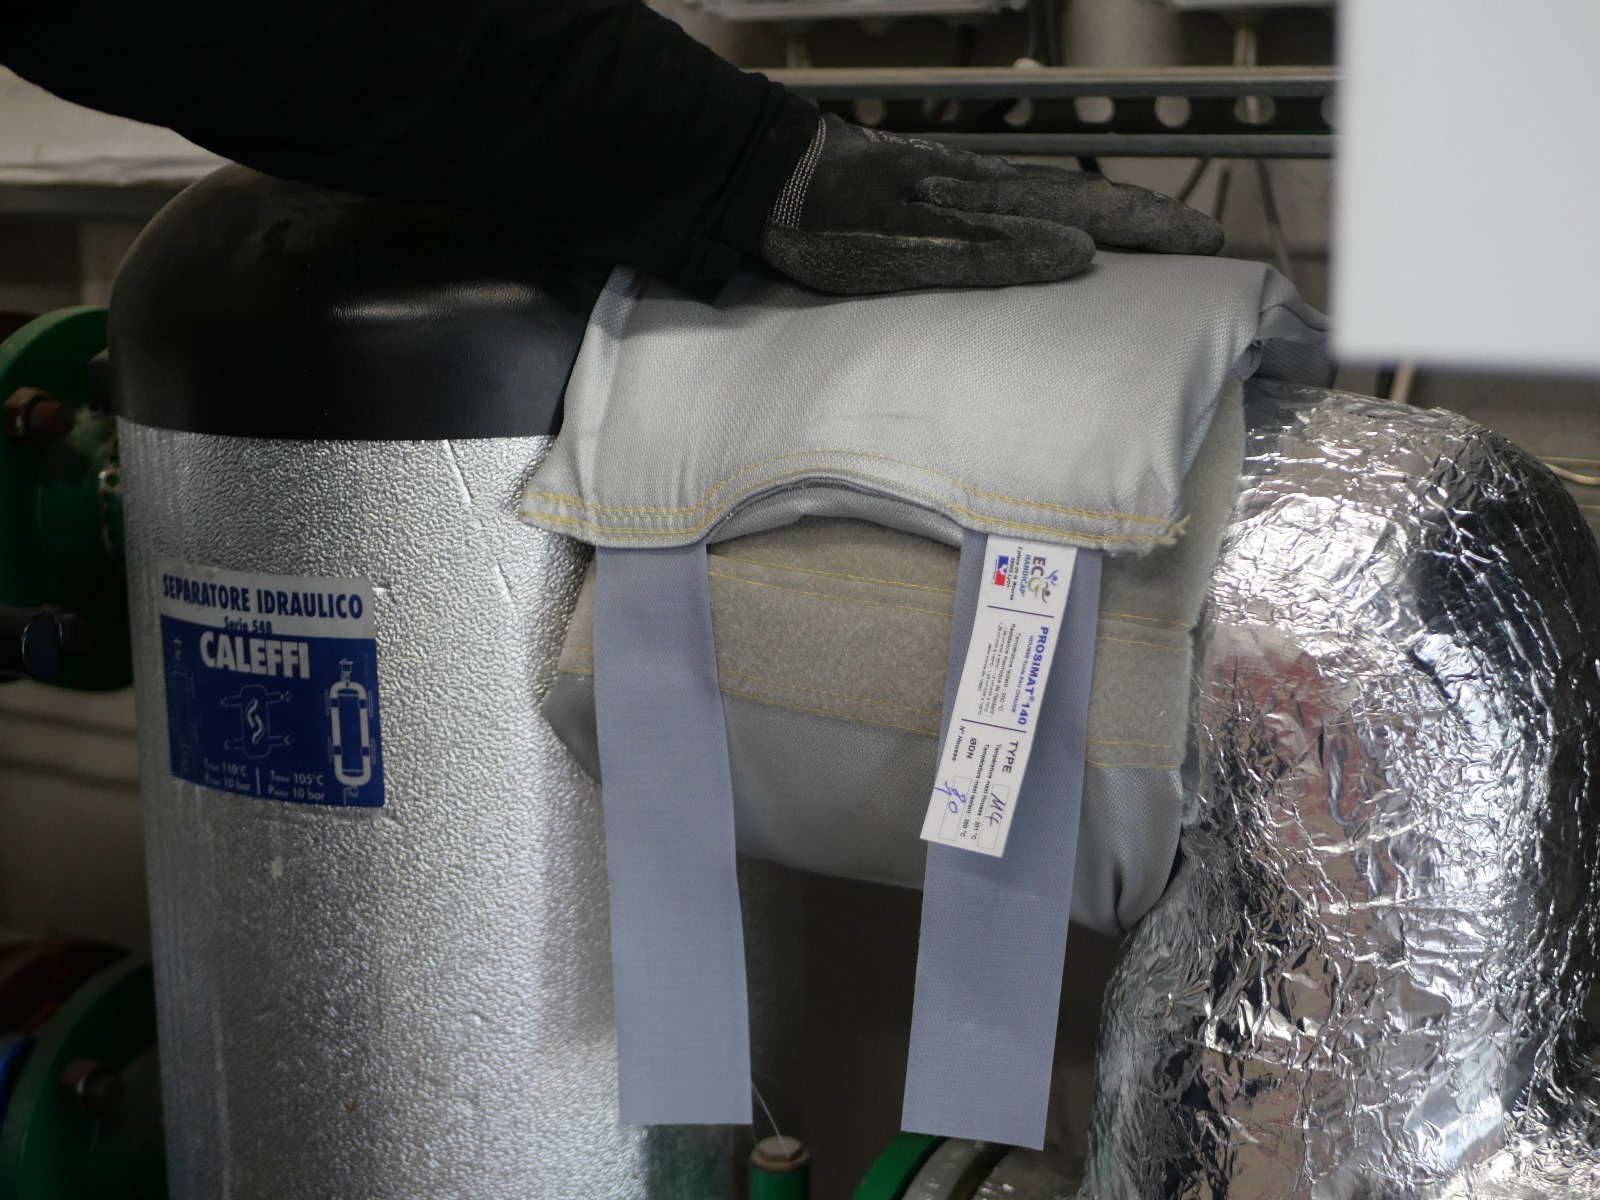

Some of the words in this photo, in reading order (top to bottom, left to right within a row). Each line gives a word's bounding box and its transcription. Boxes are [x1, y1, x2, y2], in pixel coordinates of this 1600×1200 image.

[1004, 573, 1012, 587] Lyon
[1019, 554, 1032, 595] HANDICAP
[163, 574, 250, 611] SEPARATORE
[257, 589, 363, 619] IDRAULICO
[224, 616, 249, 632] Serie
[252, 620, 272, 634] 548
[1003, 623, 1016, 654] Résistance
[1007, 631, 1021, 667] Température
[200, 631, 310, 679] CALEFFI
[996, 655, 1008, 683] thermique
[1003, 668, 1011, 687] isolant
[994, 684, 1000, 692] de
[1018, 702, 1030, 725] 140
[952, 736, 963, 761] Housse
[1002, 740, 1019, 773] TYPE
[976, 743, 989, 779] Température
[987, 743, 1001, 779] Température
[225, 777, 234, 788] 10
[237, 778, 250, 791] bar
[294, 773, 324, 786] 105°C
[971, 779, 979, 793] maxi
[982, 779, 990, 794] maxi
[293, 787, 304, 799] 10
[308, 788, 325, 800] bar
[966, 794, 975, 814] isolant
[976, 794, 986, 816] Housse
